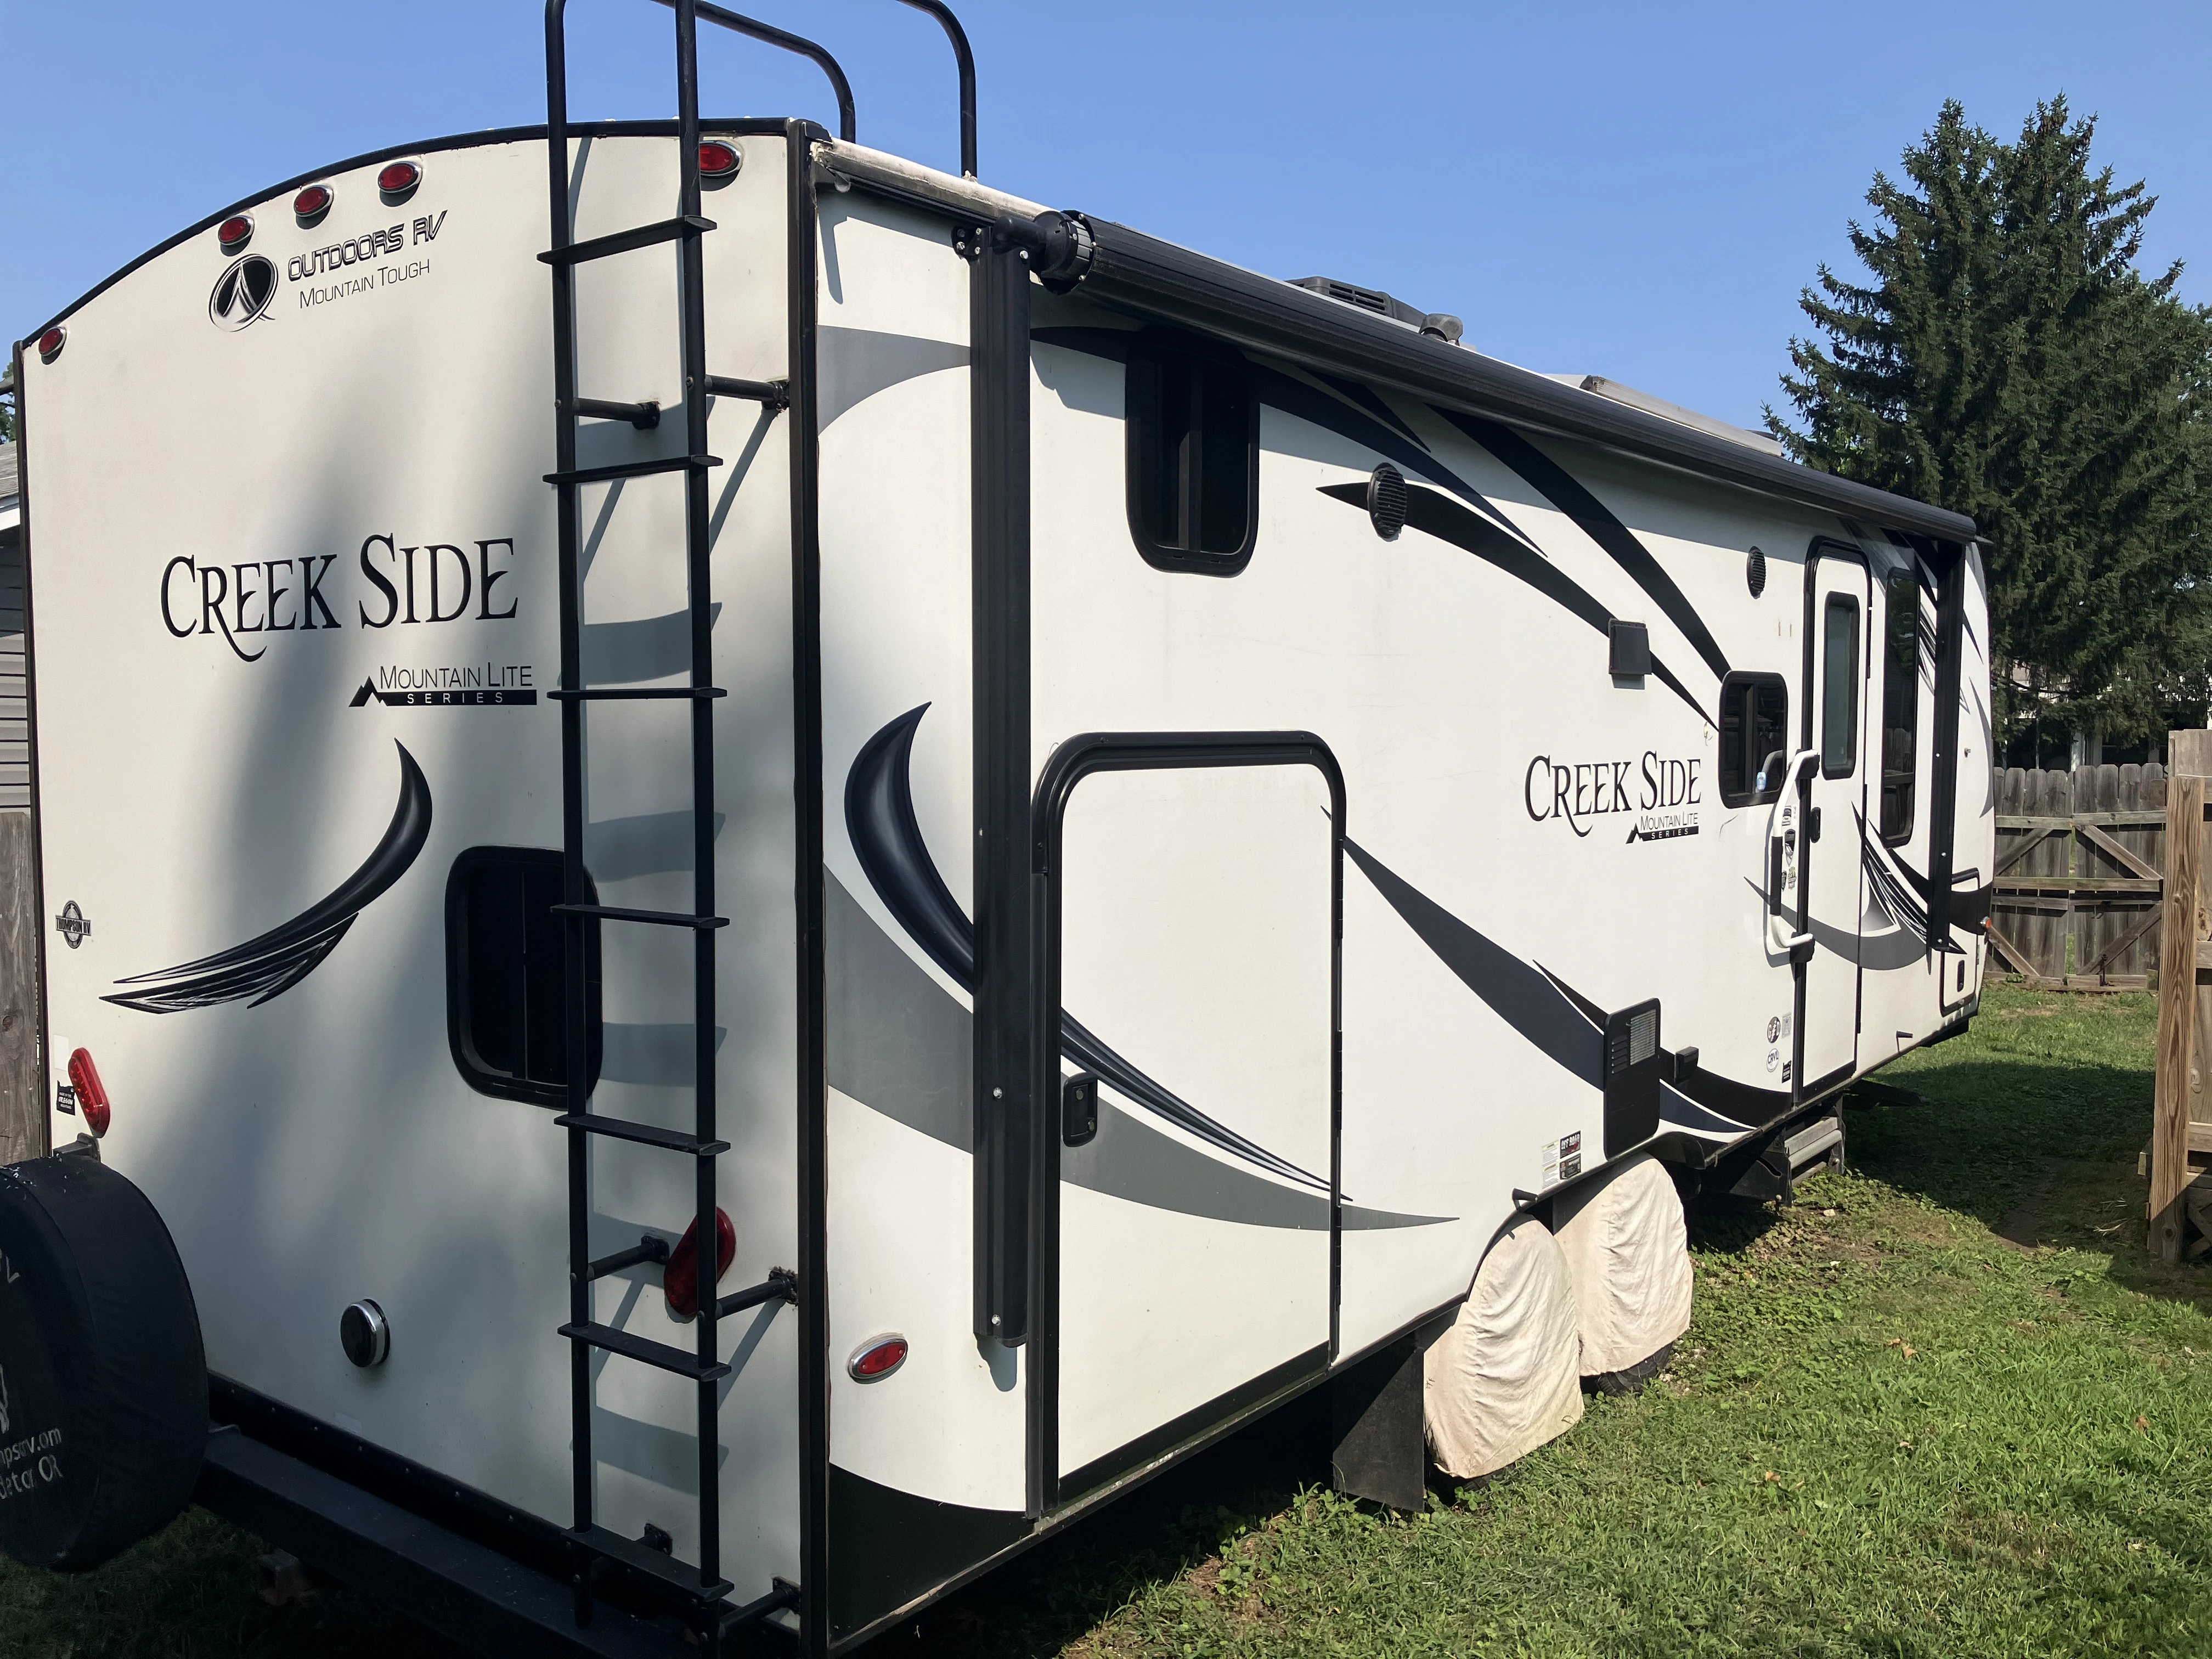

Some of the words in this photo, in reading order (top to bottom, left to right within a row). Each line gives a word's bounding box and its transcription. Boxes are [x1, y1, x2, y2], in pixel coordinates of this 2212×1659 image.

[288, 223, 405, 282] OUTDOORS
[413, 210, 448, 246] RV
[160, 554, 342, 663] CREEK
[358, 532, 519, 630] SIDE
[407, 692, 504, 704] SERIES
[1524, 754, 1633, 838] CREEK
[1639, 750, 1701, 811] SIDE
[1651, 828, 1689, 839] SERIES
